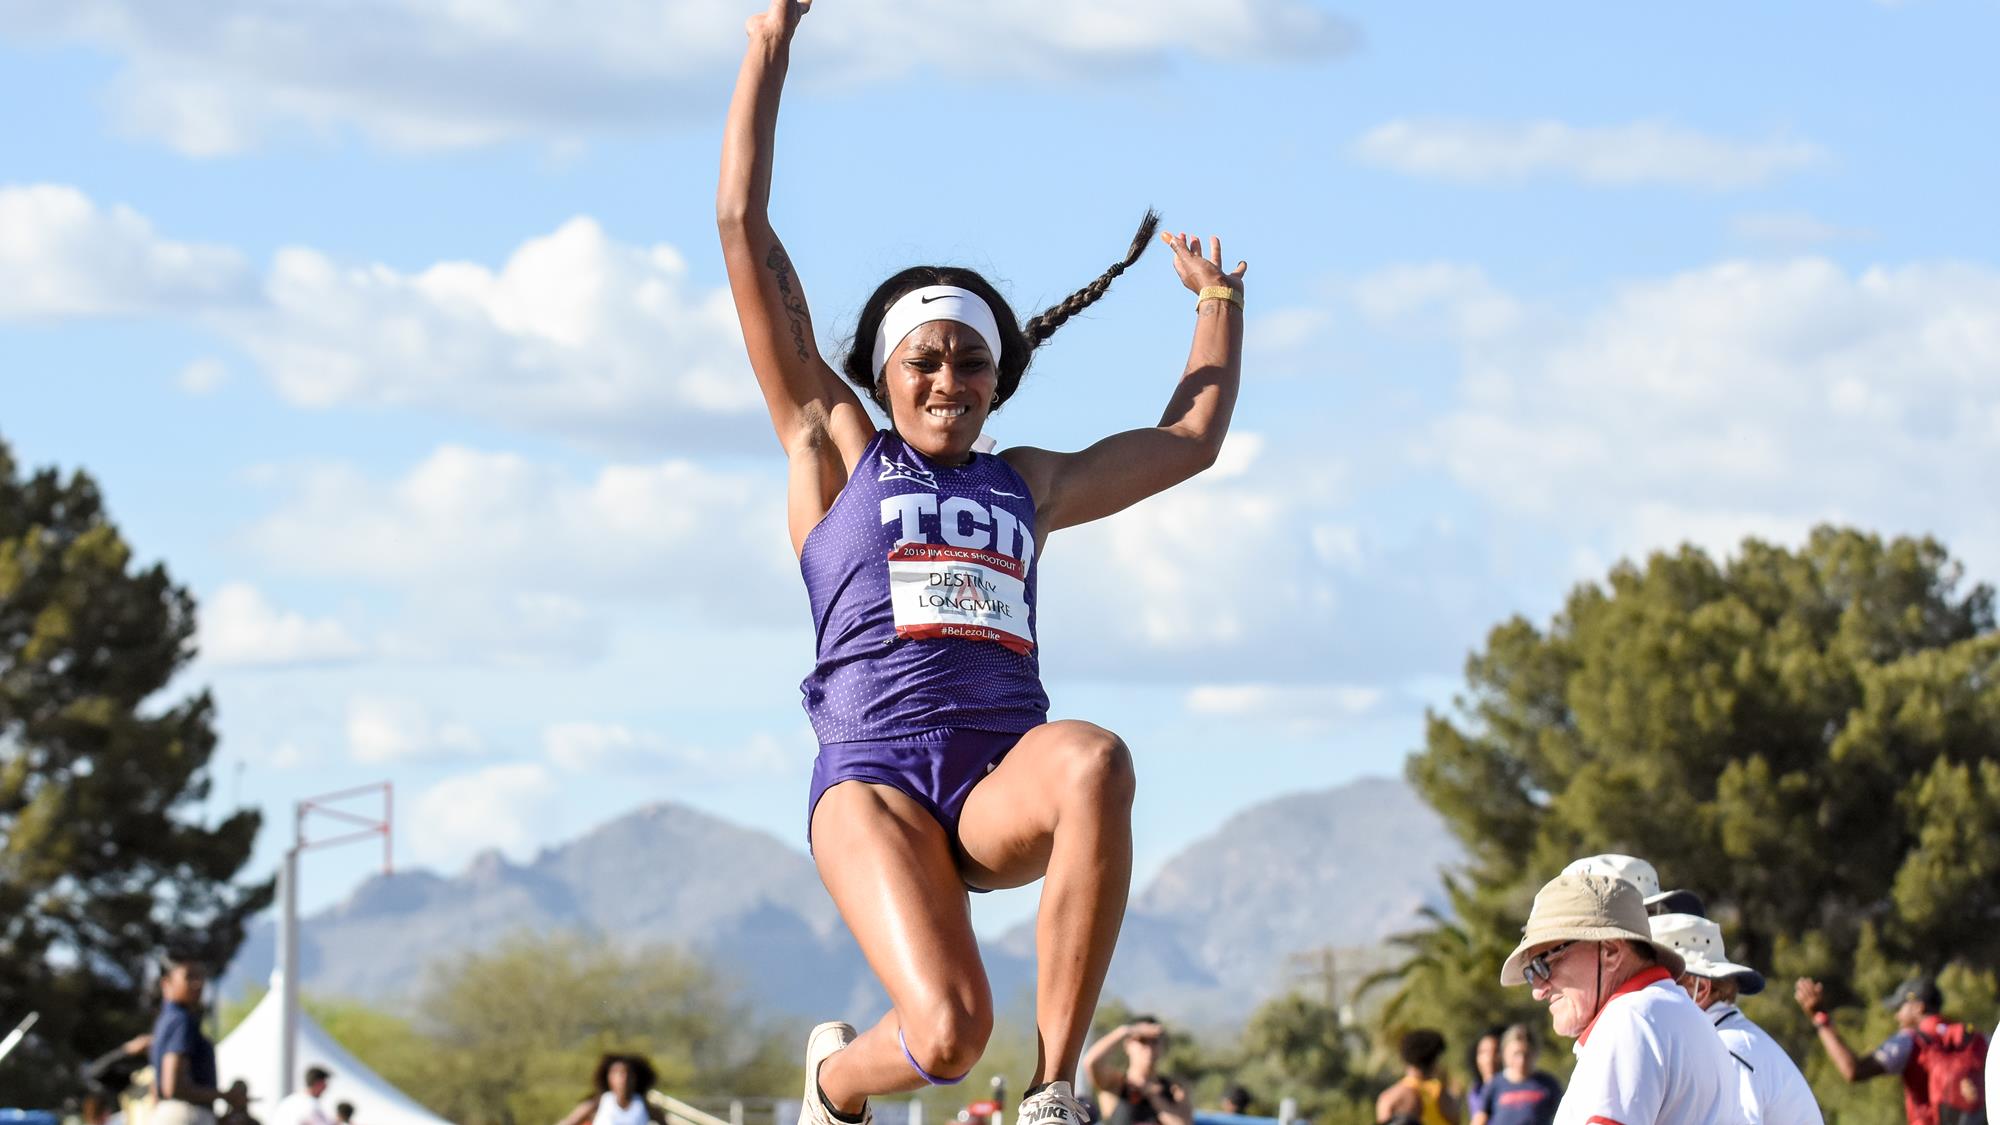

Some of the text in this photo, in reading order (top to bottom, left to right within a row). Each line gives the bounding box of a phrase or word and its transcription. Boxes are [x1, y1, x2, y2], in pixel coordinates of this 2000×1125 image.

[904, 547, 1016, 571] 2019 JIM CLICK SHOOTOUT
[929, 572, 997, 593] DESTINY
[919, 594, 1013, 618] LONGMIRE
[941, 626, 1001, 640] #BeLezoLike
[1029, 1106, 1069, 1124] NIKE
